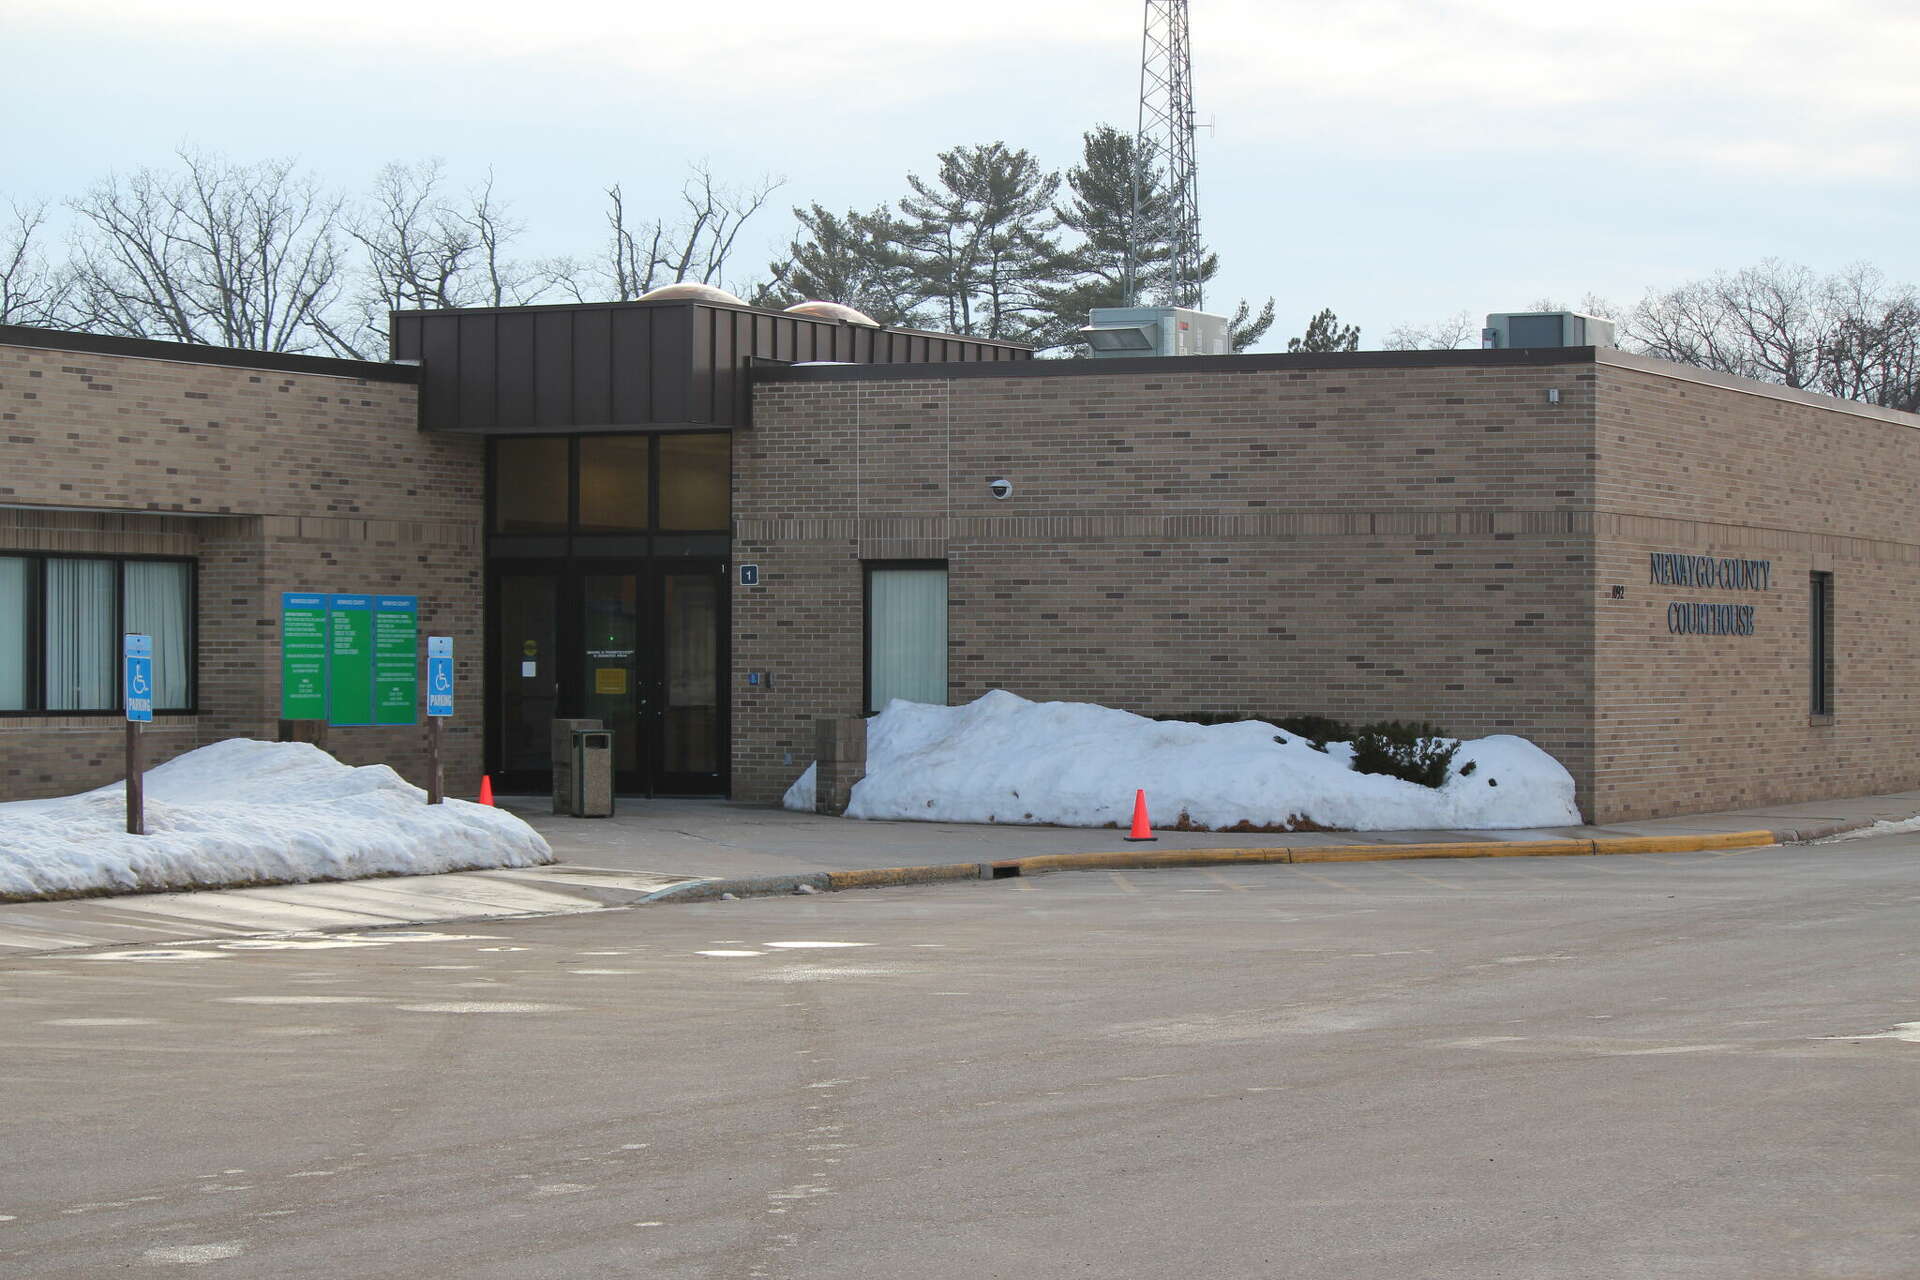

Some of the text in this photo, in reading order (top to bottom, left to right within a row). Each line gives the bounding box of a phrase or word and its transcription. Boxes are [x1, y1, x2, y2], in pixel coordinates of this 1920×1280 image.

[746, 570, 751, 581] 1
[1650, 553, 1770, 592] NEWAYGO COUNTY
[1667, 601, 1755, 636] COURTHOUSE
[128, 697, 151, 712] PARKING
[430, 694, 452, 707] PARKING
